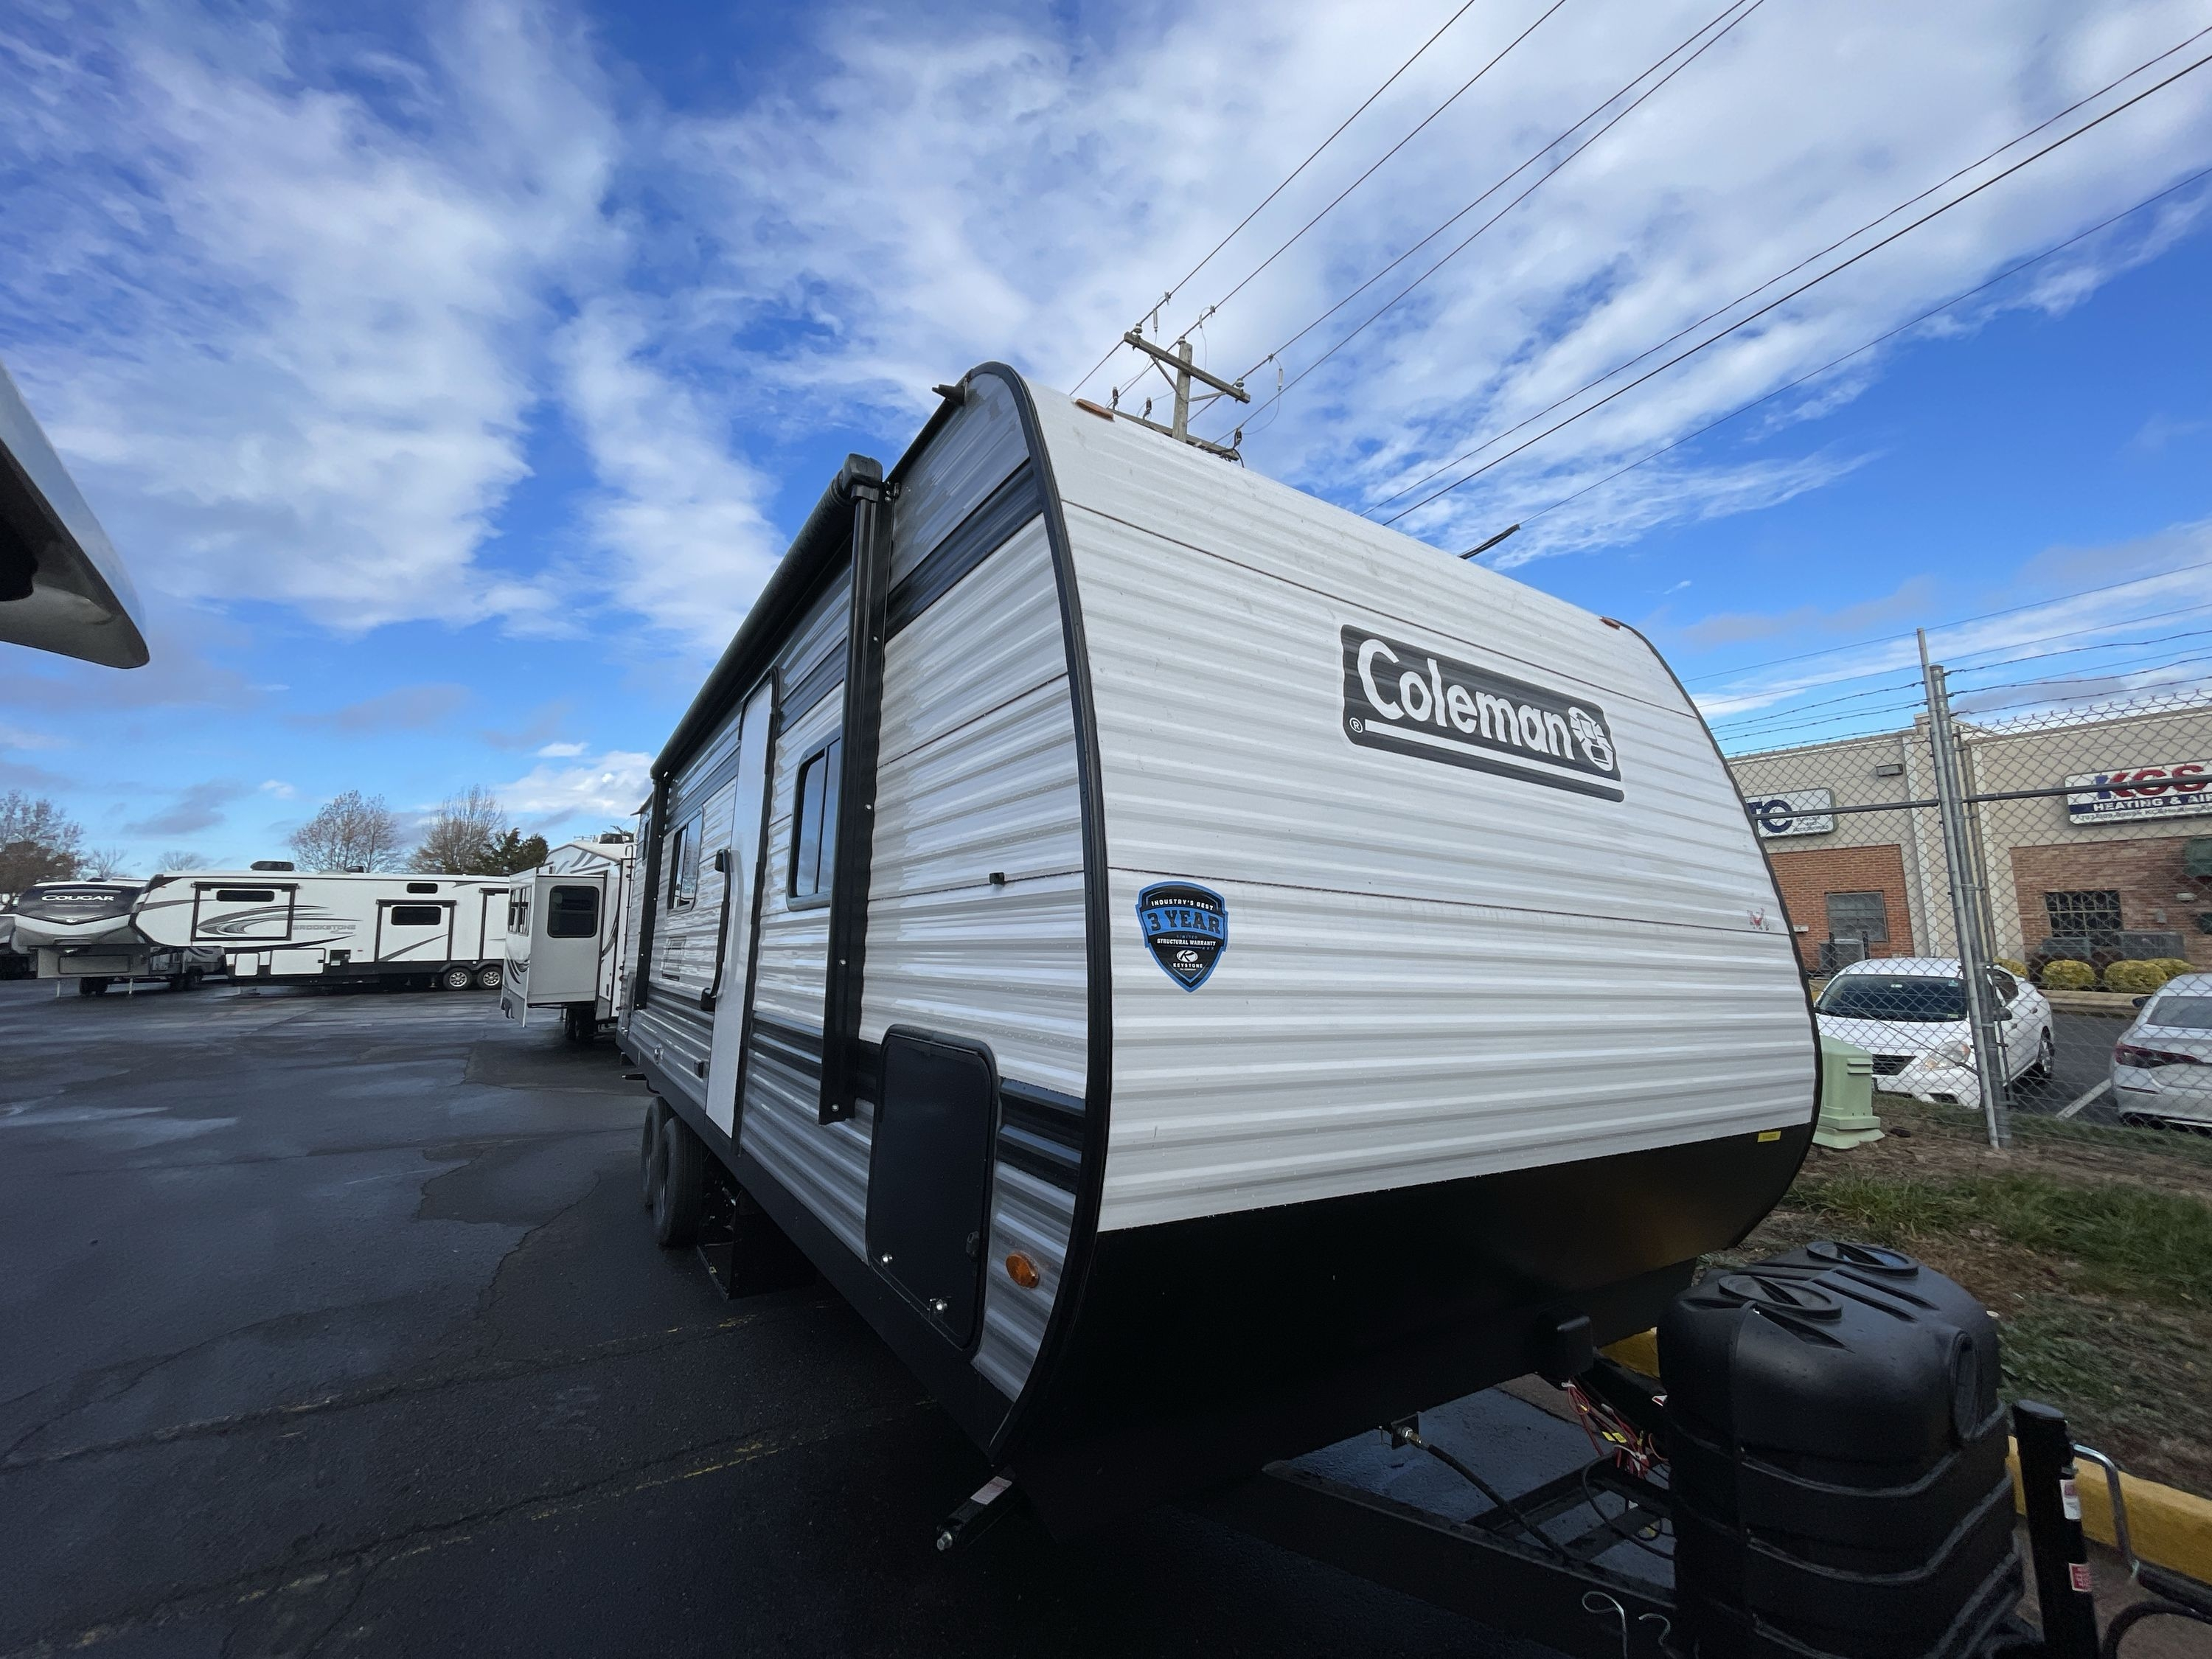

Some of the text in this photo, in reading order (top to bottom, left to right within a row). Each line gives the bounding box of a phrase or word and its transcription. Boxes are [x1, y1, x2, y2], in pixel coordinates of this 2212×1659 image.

[1357, 638, 1576, 760] Coleman
[2093, 798, 2164, 812] HEATING
[2169, 796, 2182, 805] &
[1151, 898, 1214, 911] INDUSTRY'S BEST
[1147, 910, 1221, 934] 3 YEAR
